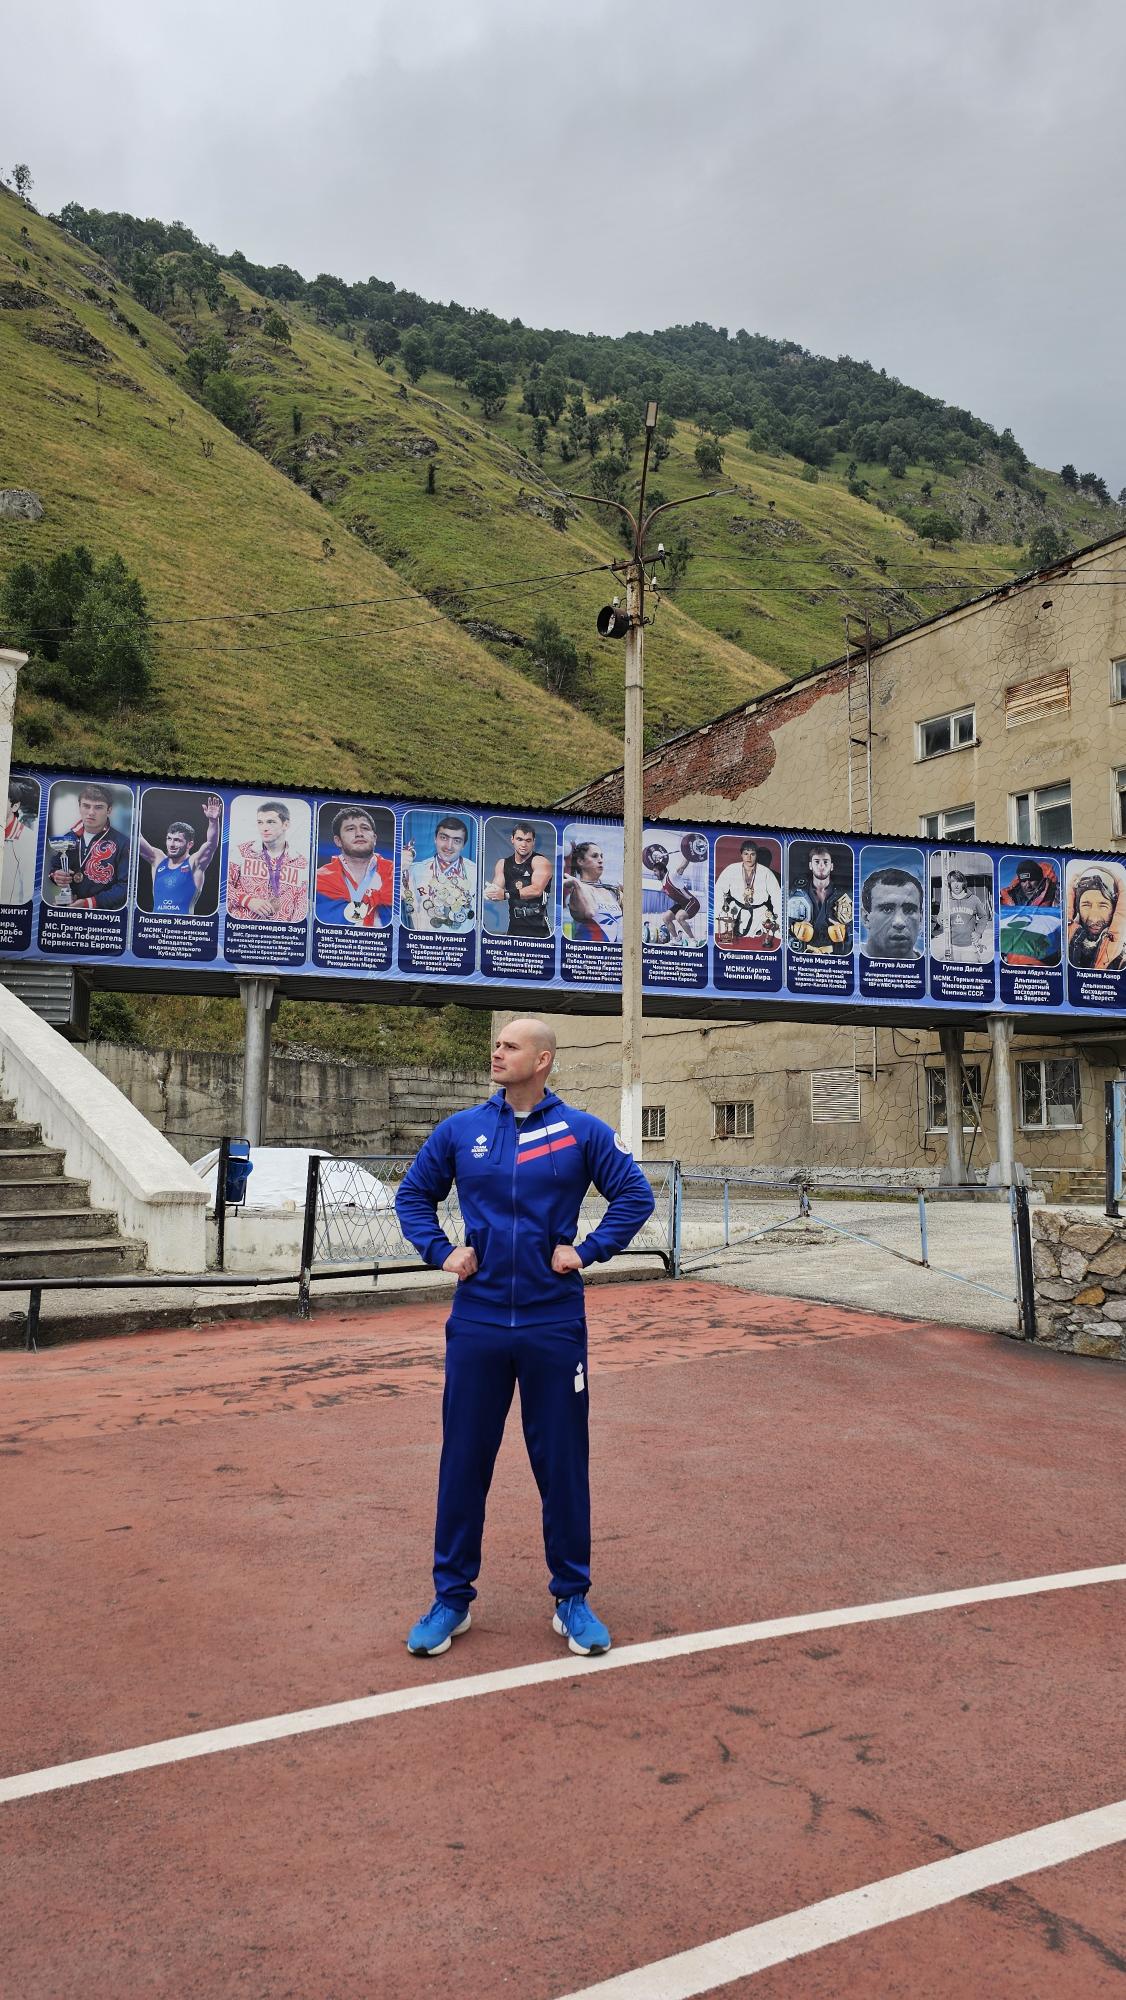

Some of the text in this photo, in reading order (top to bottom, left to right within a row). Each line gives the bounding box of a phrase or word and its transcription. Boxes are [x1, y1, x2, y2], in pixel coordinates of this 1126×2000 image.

[47, 910, 120, 923] Башиев Махмуд
[61, 924, 120, 934] Греко-римская
[227, 922, 286, 932] Курамагомедов
[75, 933, 122, 942] Победитель
[345, 929, 390, 939] Хаджимурат
[41, 939, 88, 947] Первенства
[514, 940, 554, 949] Половников
[792, 956, 813, 964] Тебуев
